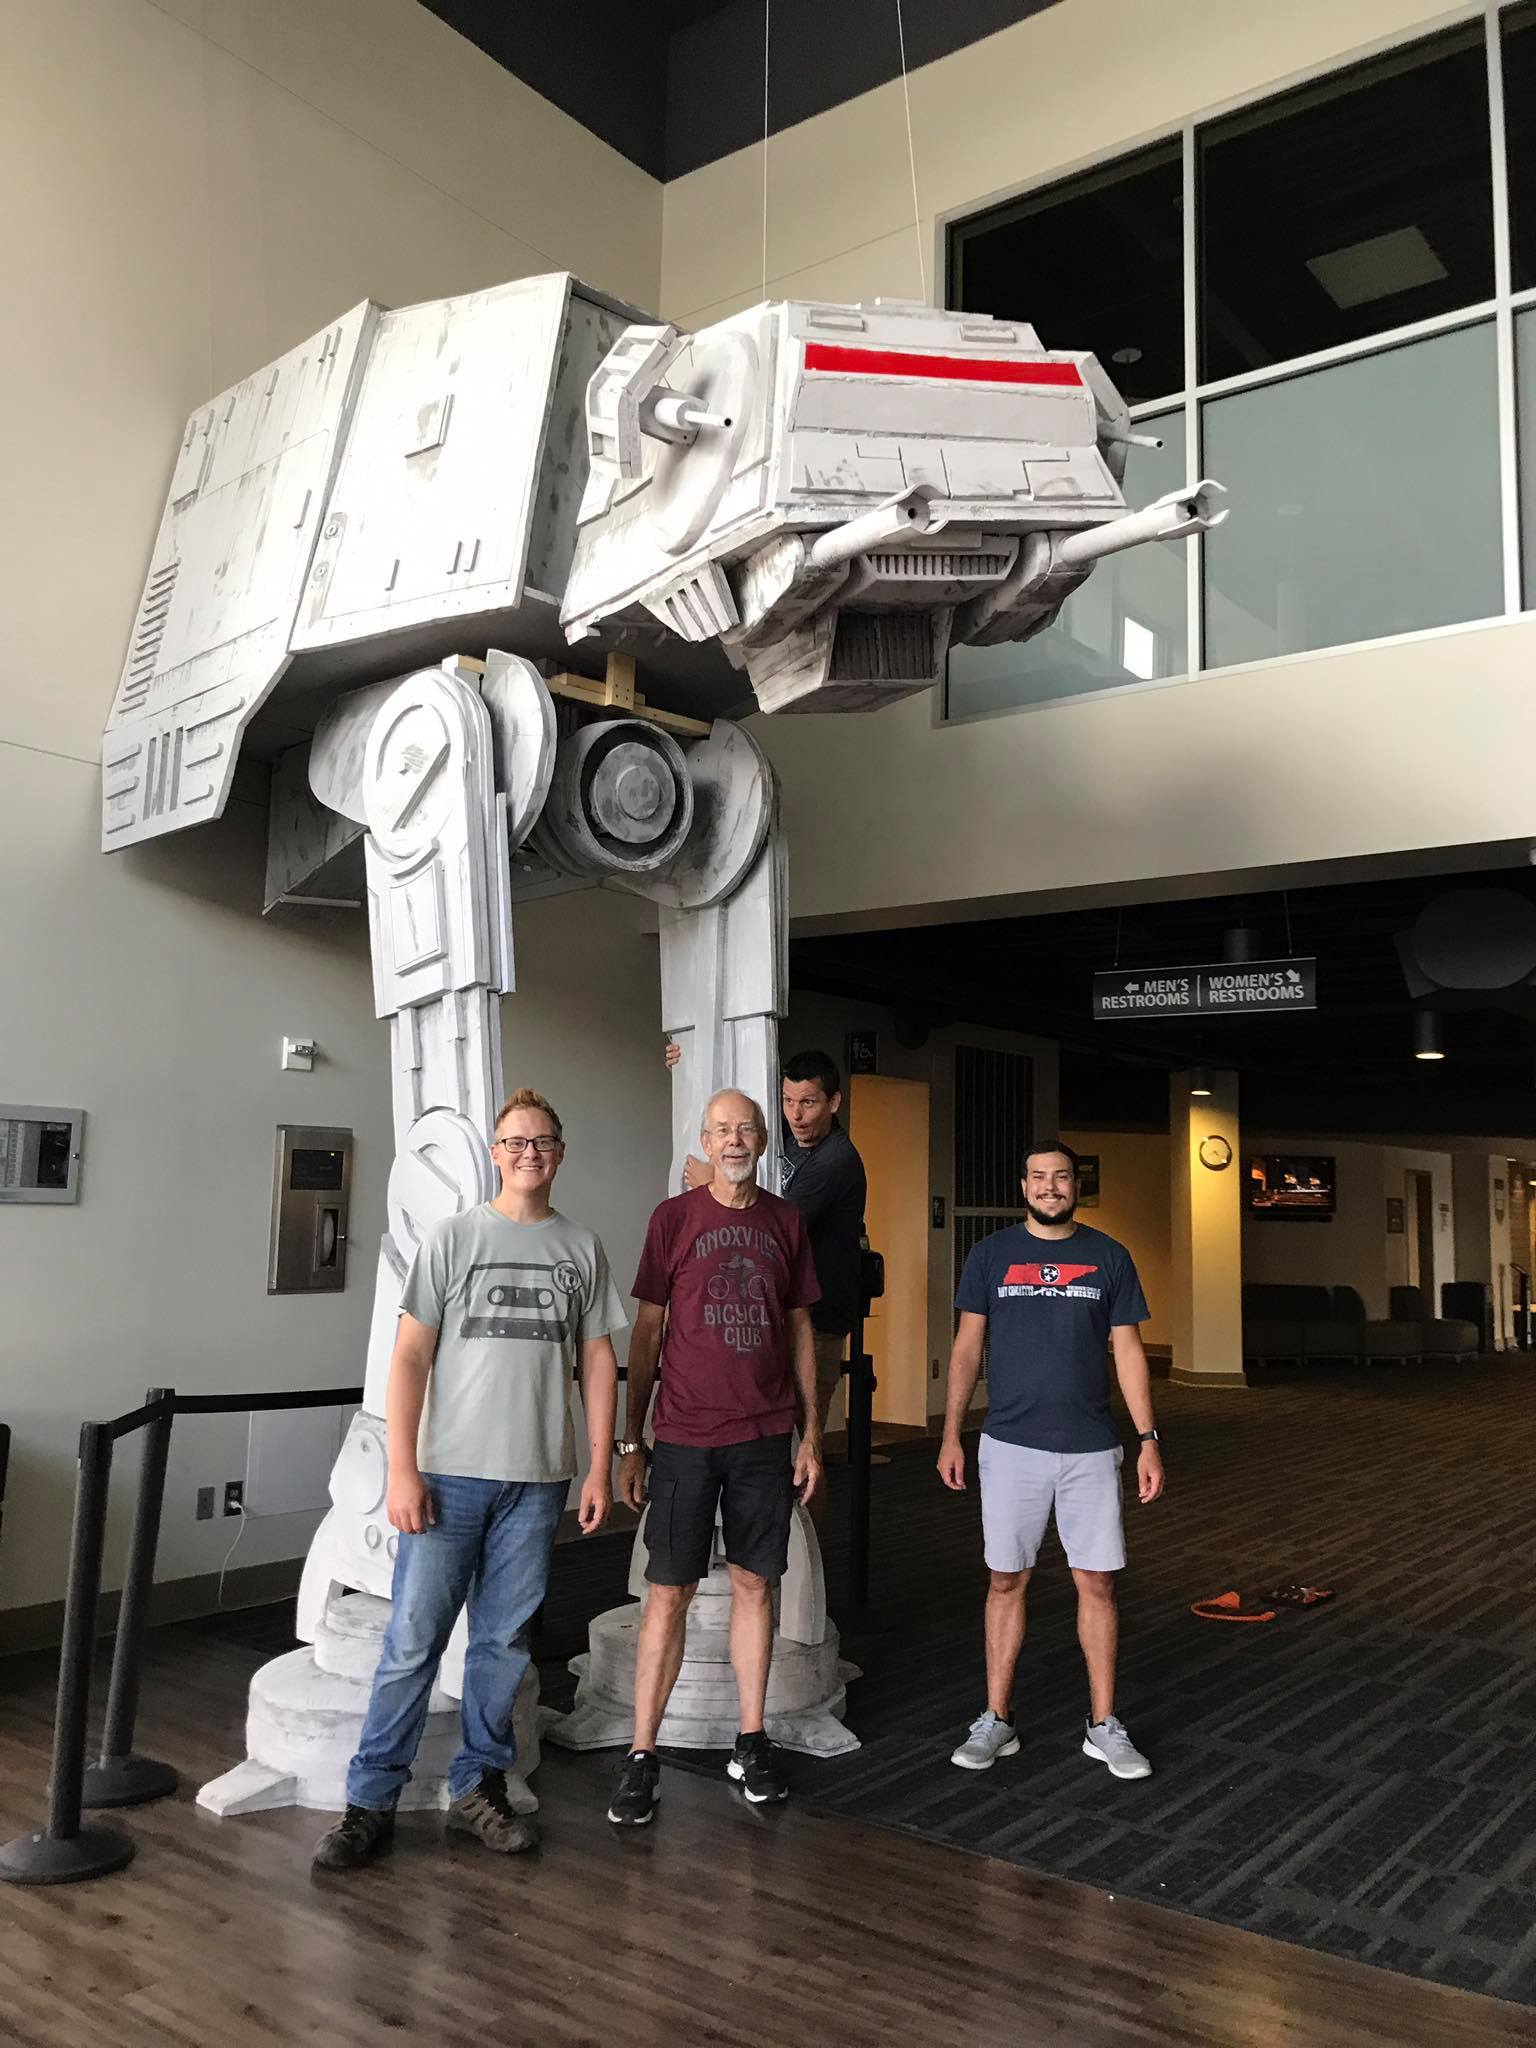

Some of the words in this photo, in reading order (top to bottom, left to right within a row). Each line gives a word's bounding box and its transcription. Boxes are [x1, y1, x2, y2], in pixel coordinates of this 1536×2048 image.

[1144, 979, 1189, 994] MEN'S
[1209, 973, 1284, 990] WOMEN'S
[1102, 992, 1190, 1009] RESTROOMS
[1209, 985, 1305, 1004] RESTROOMS
[704, 1304, 771, 1326] BICYCL
[724, 1326, 762, 1352] CLUB
